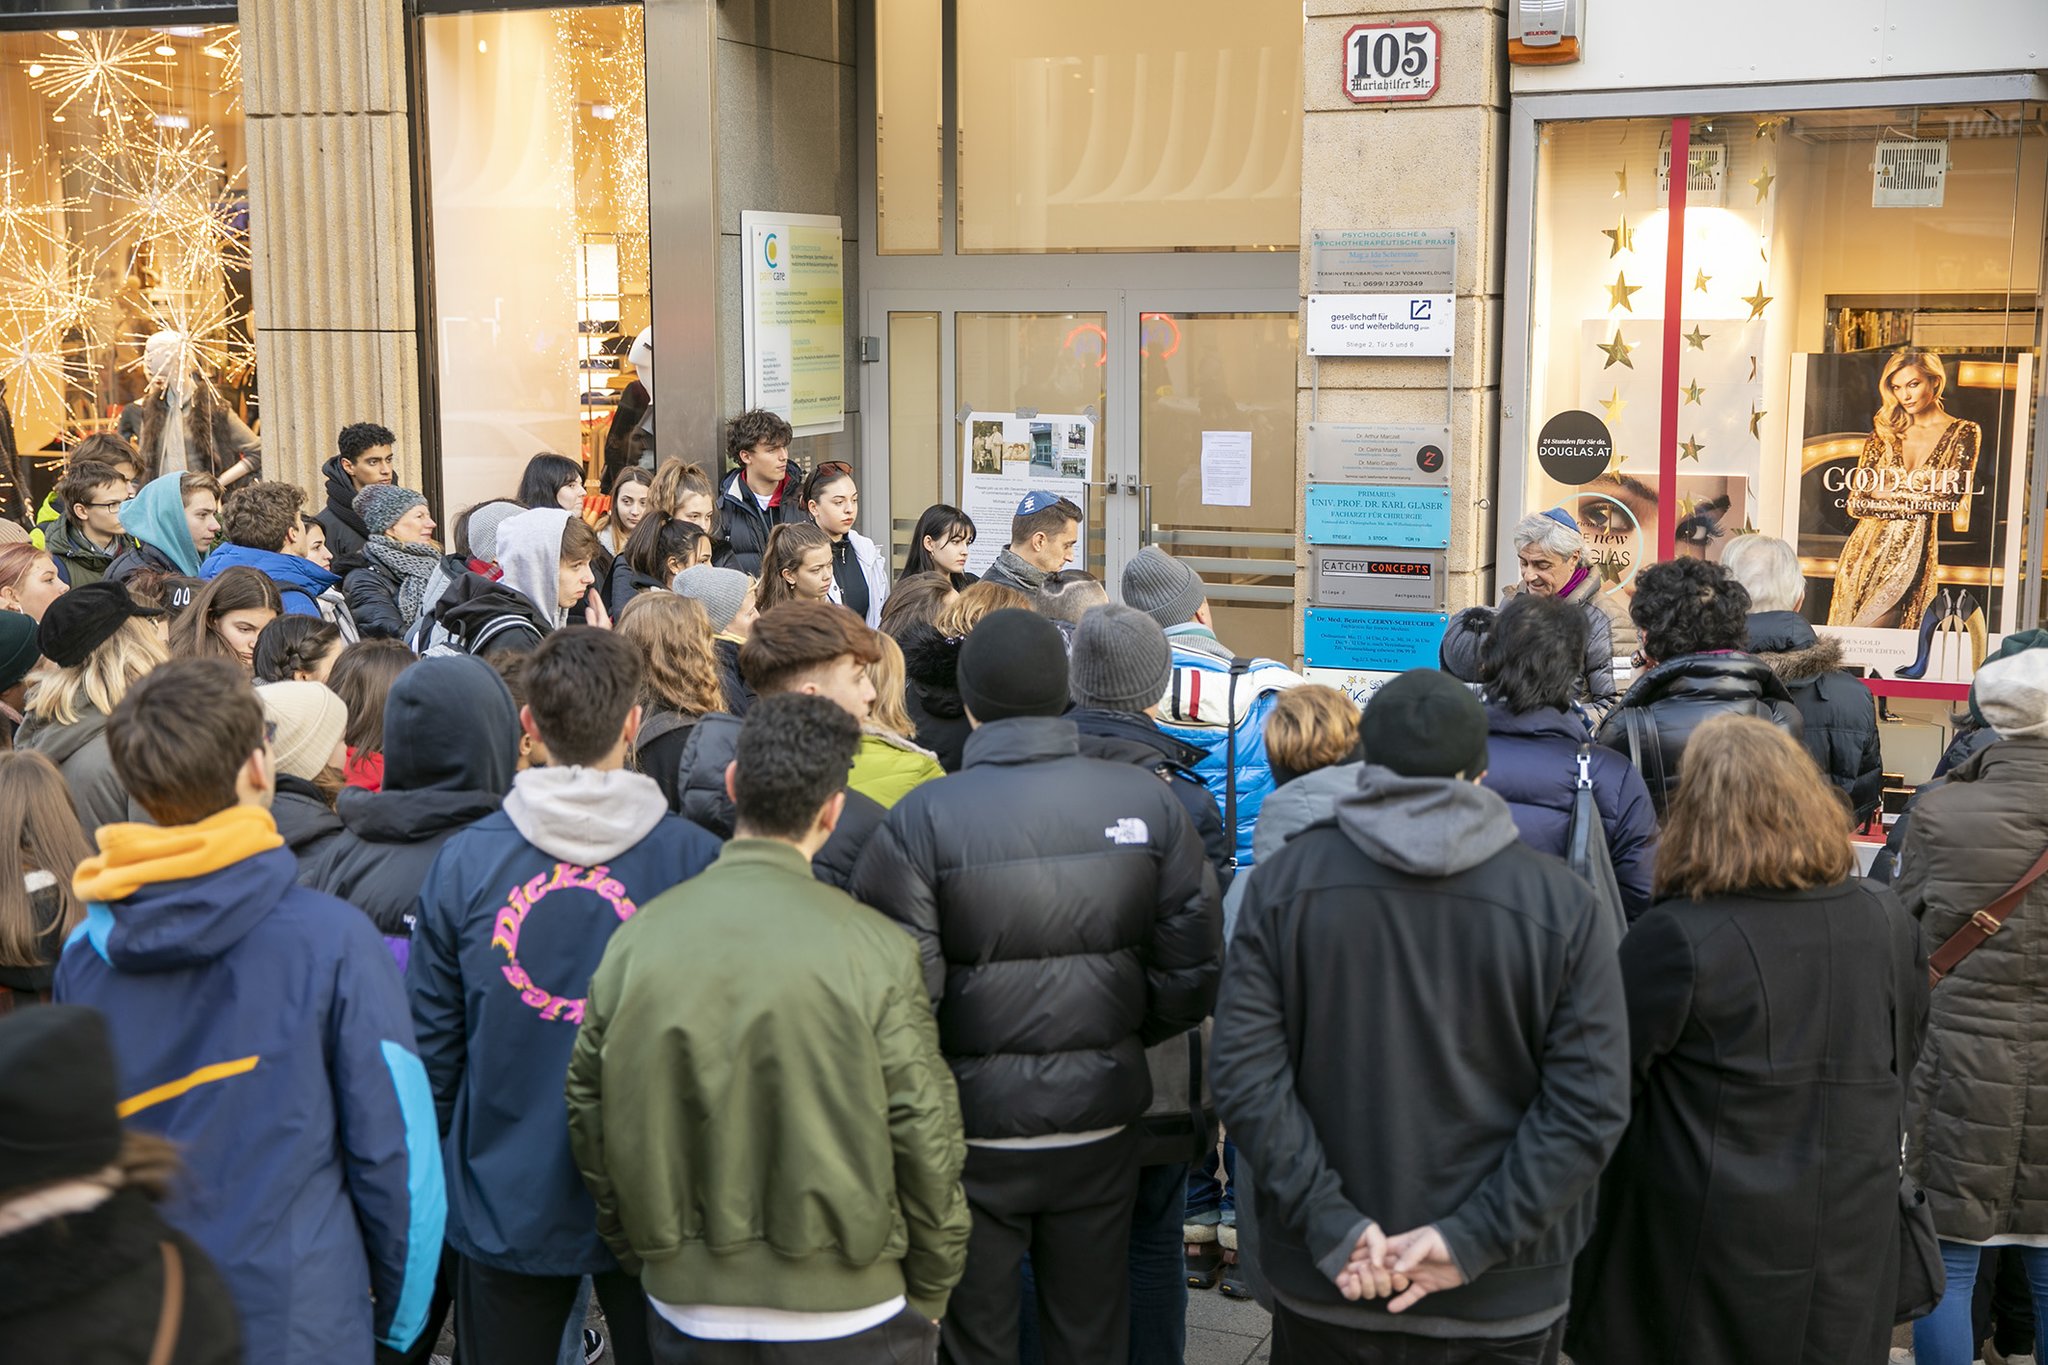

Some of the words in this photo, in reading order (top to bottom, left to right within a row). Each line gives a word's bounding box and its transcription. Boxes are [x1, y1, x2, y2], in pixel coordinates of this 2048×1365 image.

[1353, 32, 1428, 79] 105
[1351, 78, 1411, 91] Mariahilfer
[1413, 77, 1432, 89] Str.
[1313, 239, 1422, 247] PSYCHOTHERAPEUTISCHE
[1330, 313, 1377, 322] gesellschaft
[1378, 313, 1389, 321] für
[1330, 323, 1348, 331] aus-
[1349, 322, 1365, 330] und
[1366, 322, 1420, 332] weiterbildung
[1346, 341, 1367, 349] Stiege
[1576, 438, 1587, 446] für
[1539, 446, 1611, 457] DOUGLAS.AT
[1823, 466, 1900, 493] GOOD
[1907, 467, 1985, 495] GIRL
[1357, 490, 1396, 498] PRIMARIUS
[1311, 499, 1336, 507] UNIV.
[1337, 499, 1363, 508] PROF.
[1364, 501, 1380, 509] DR.
[1381, 501, 1406, 509] KARL
[1407, 501, 1443, 510] GLASER
[1834, 499, 1899, 511] CAROLINA
[1904, 499, 1969, 512] HERRERA
[1368, 511, 1382, 519] FÜR
[1383, 512, 1423, 520] CHIRURGIE
[1875, 512, 1898, 520] NEW
[1900, 513, 1928, 521] YORK
[1593, 534, 1628, 545] new
[1591, 549, 1631, 567] GLAS
[1323, 561, 1365, 571] CATCHY
[1370, 563, 1429, 575] CONCEPTS
[492, 863, 638, 965] Dickies
[501, 958, 588, 1025] kies
